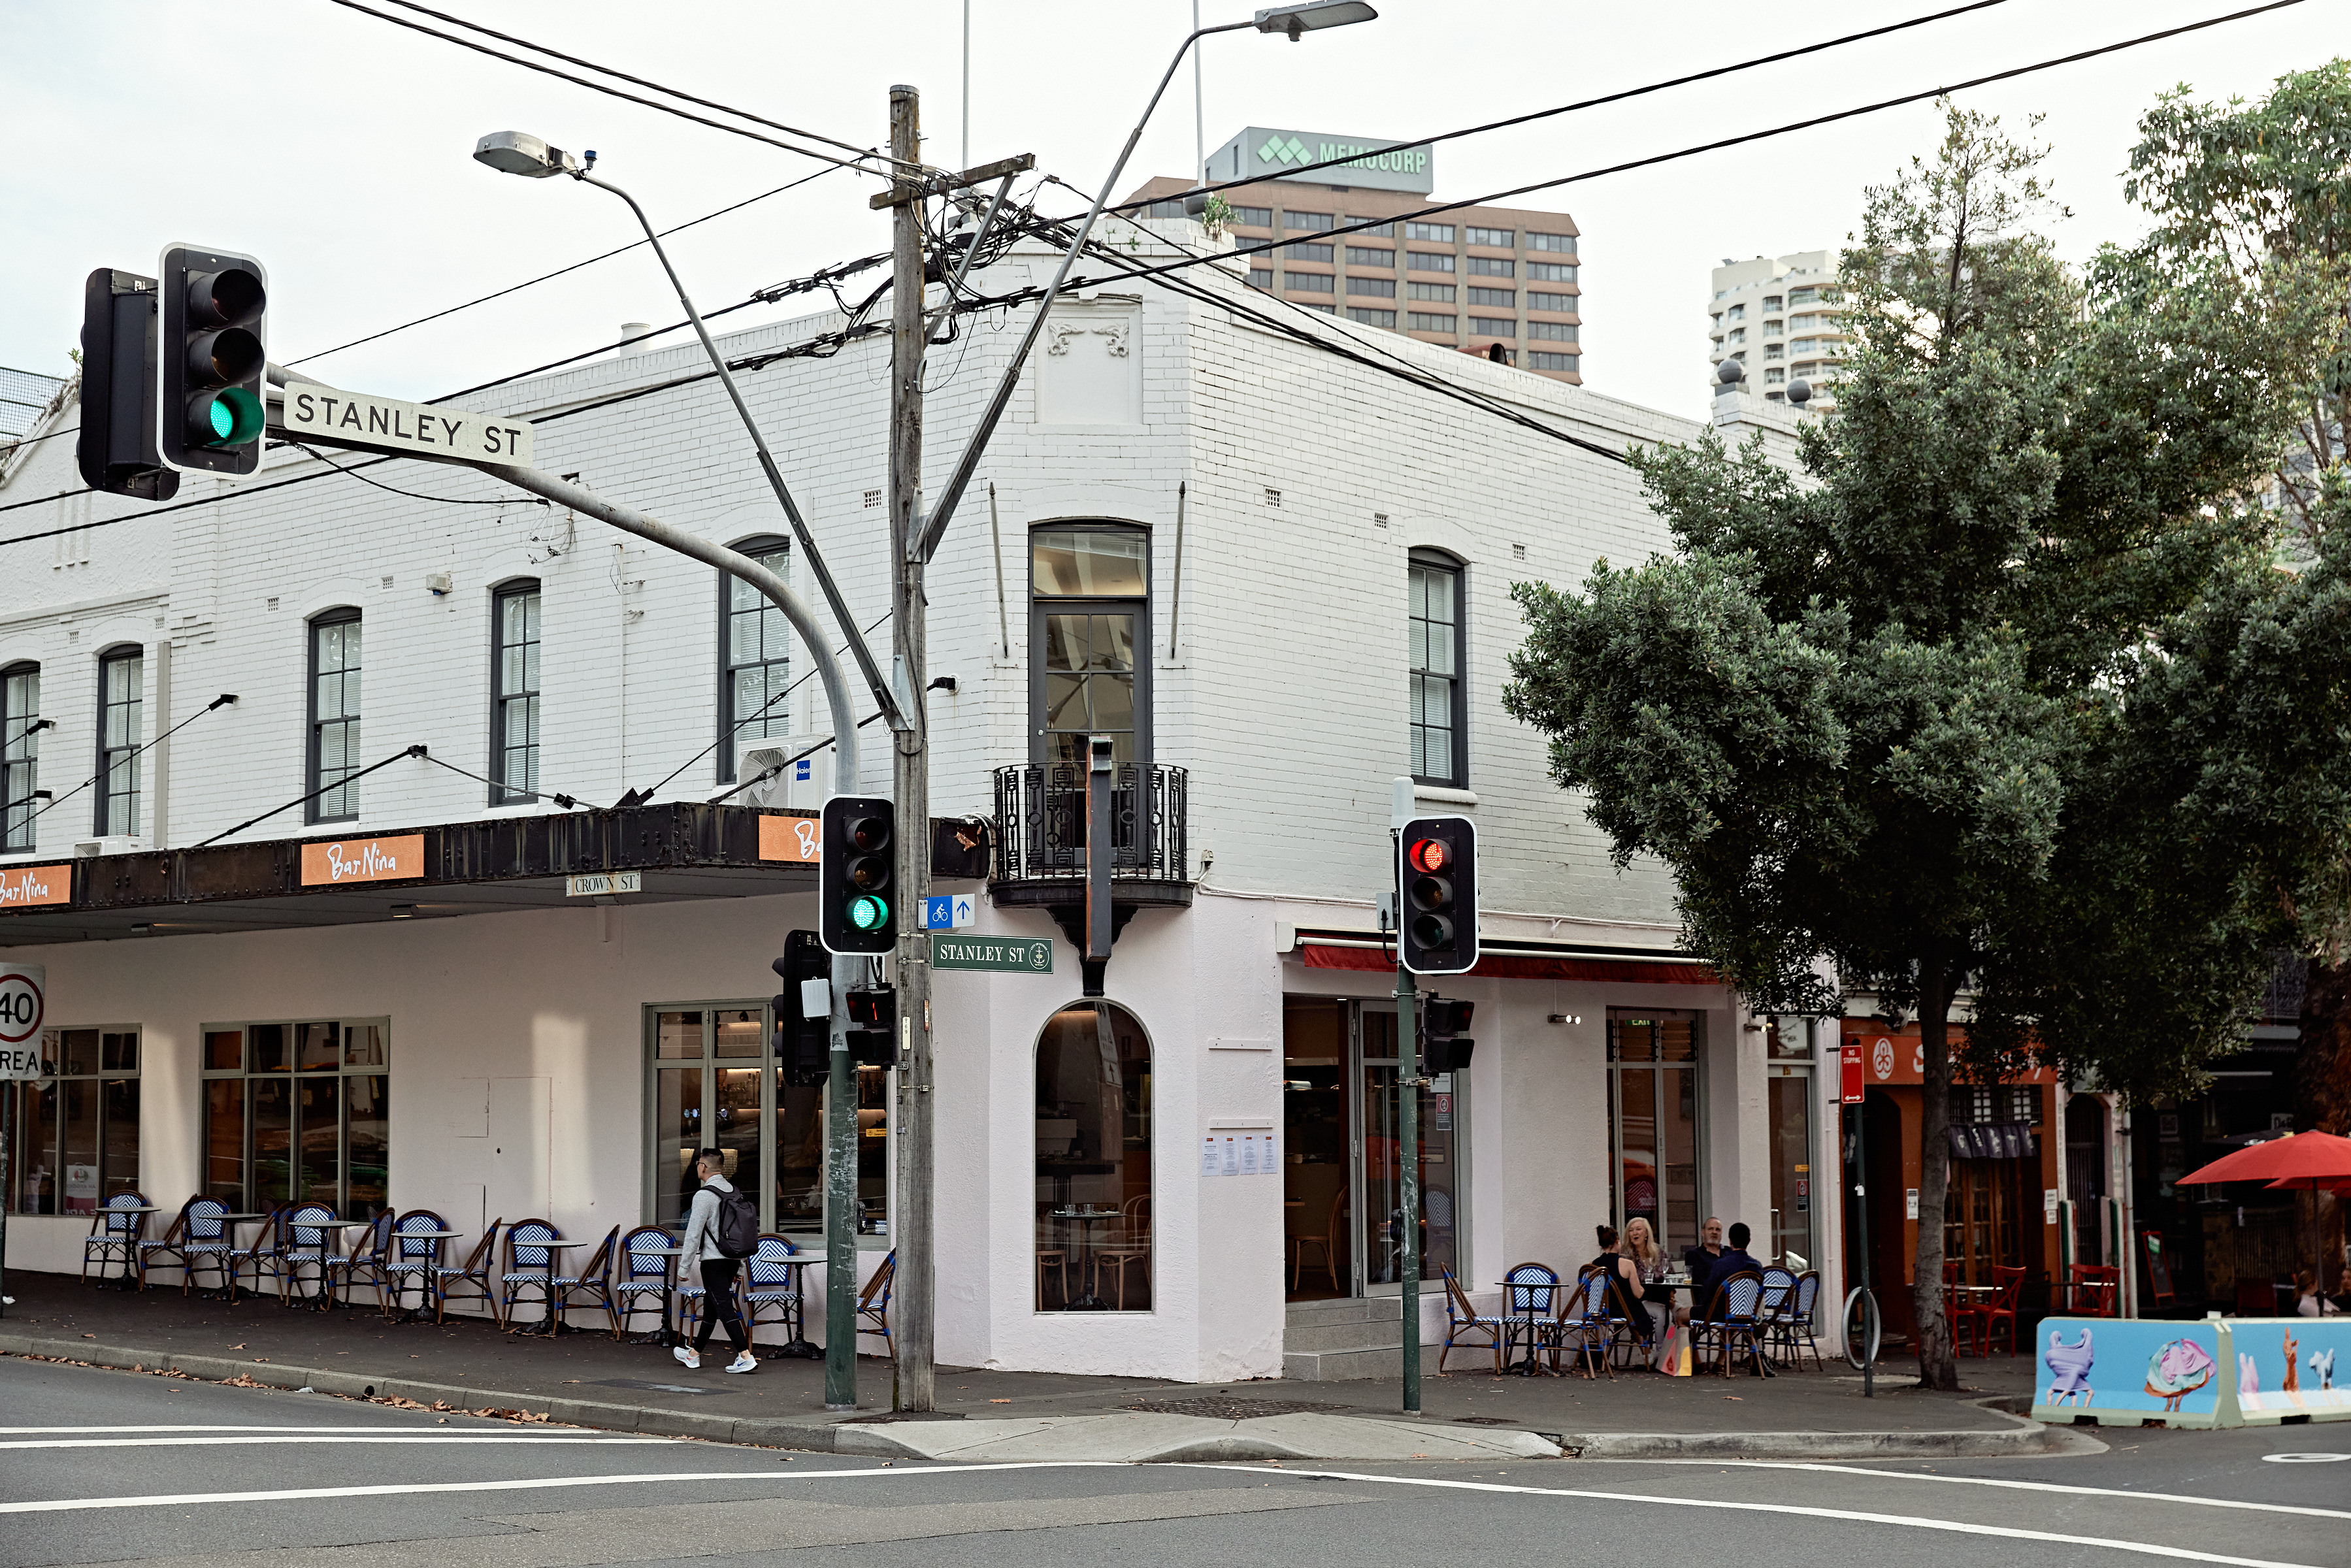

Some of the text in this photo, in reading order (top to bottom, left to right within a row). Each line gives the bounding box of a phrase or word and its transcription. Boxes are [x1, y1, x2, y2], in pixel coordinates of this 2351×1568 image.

[1319, 142, 1426, 174] MEMOCORP
[295, 393, 521, 456] STANLEY ST
[797, 766, 810, 775] Haier
[327, 841, 397, 881] Bar Nina
[20, 871, 48, 904] Nina
[576, 875, 636, 892] CROWN ST
[940, 943, 1025, 963] STANLEY ST
[0, 992, 34, 1025] 40
